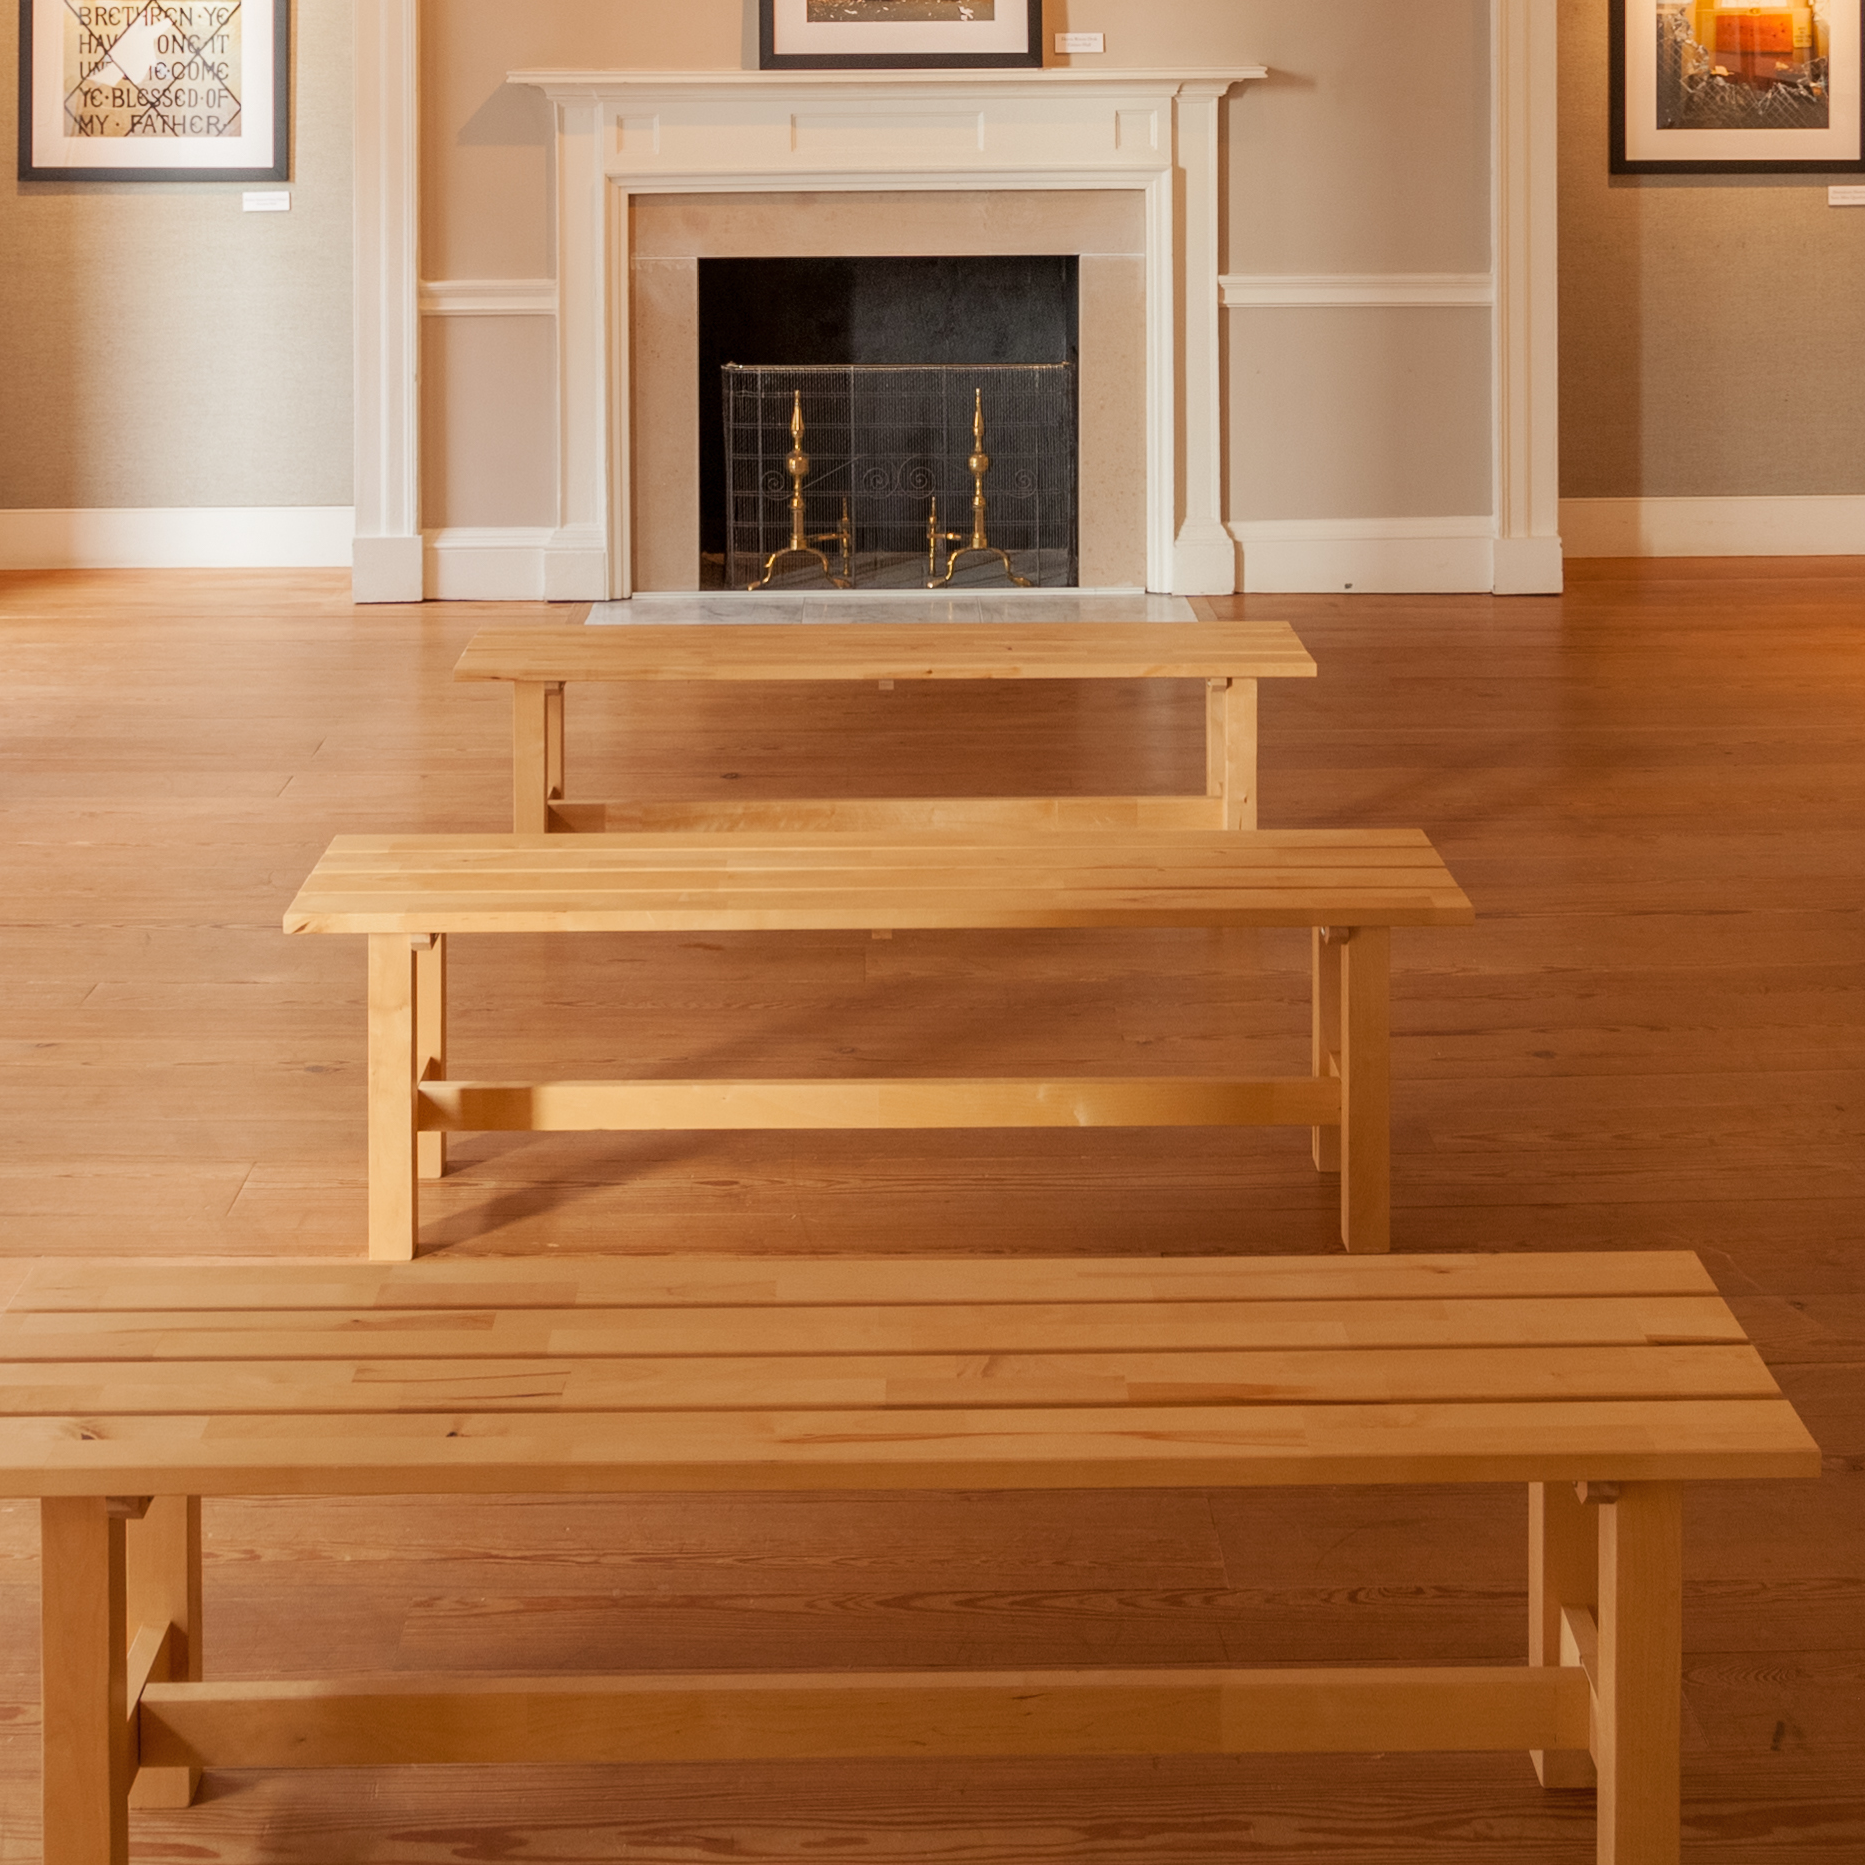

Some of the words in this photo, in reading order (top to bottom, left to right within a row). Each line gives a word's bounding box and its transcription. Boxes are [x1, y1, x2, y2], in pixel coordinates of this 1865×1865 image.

[79, 7, 192, 26] BRETHREN
[203, 7, 229, 26] YE
[80, 34, 118, 54] HAV
[158, 34, 200, 54] ONE
[211, 35, 229, 54] IT
[172, 62, 228, 80] COME
[80, 88, 103, 107] YE
[112, 88, 198, 108] BLESSED
[206, 88, 228, 108] OF
[79, 115, 109, 134] MY
